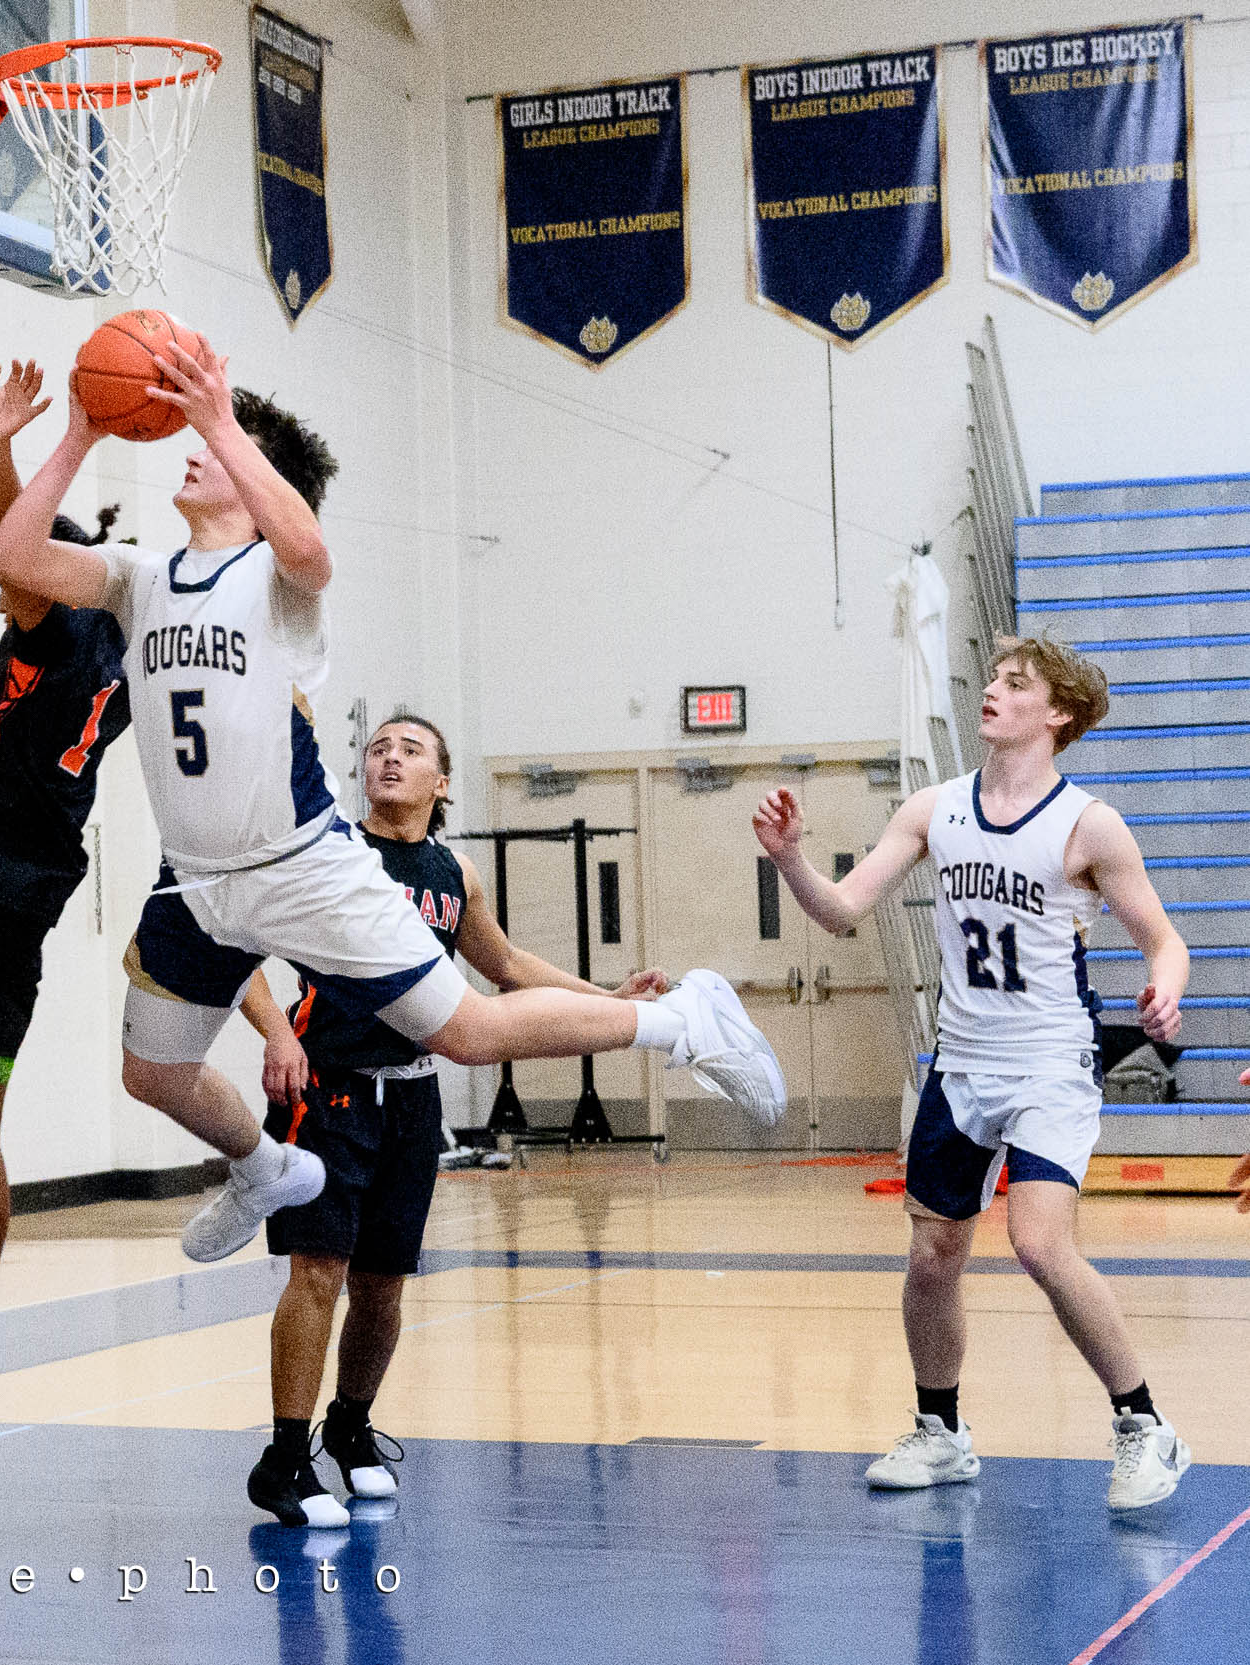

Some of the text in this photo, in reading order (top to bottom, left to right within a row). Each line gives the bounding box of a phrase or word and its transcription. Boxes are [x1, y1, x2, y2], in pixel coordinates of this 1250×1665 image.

[994, 30, 1176, 74] BOYS ICE HOCKEY
[754, 56, 930, 100] BOYS INDOOR TRACK
[1009, 73, 1070, 96] LEAGUE
[510, 85, 671, 128] GIRLS INDOOR TRACK
[771, 88, 914, 122] LEAGUE CHAMPIONS
[523, 117, 660, 149] LEAGUE CHAMPIONS
[1093, 161, 1184, 187] CHAMPIONS
[757, 184, 937, 219] VOCATIONAL CHAMPIONS
[511, 210, 680, 244] VOCATIONAL CHAMPIONS
[697, 693, 734, 724] EXIT
[58, 679, 121, 778] 1
[168, 687, 209, 778] 5
[405, 887, 460, 934] AN
[960, 917, 1028, 993] 21
